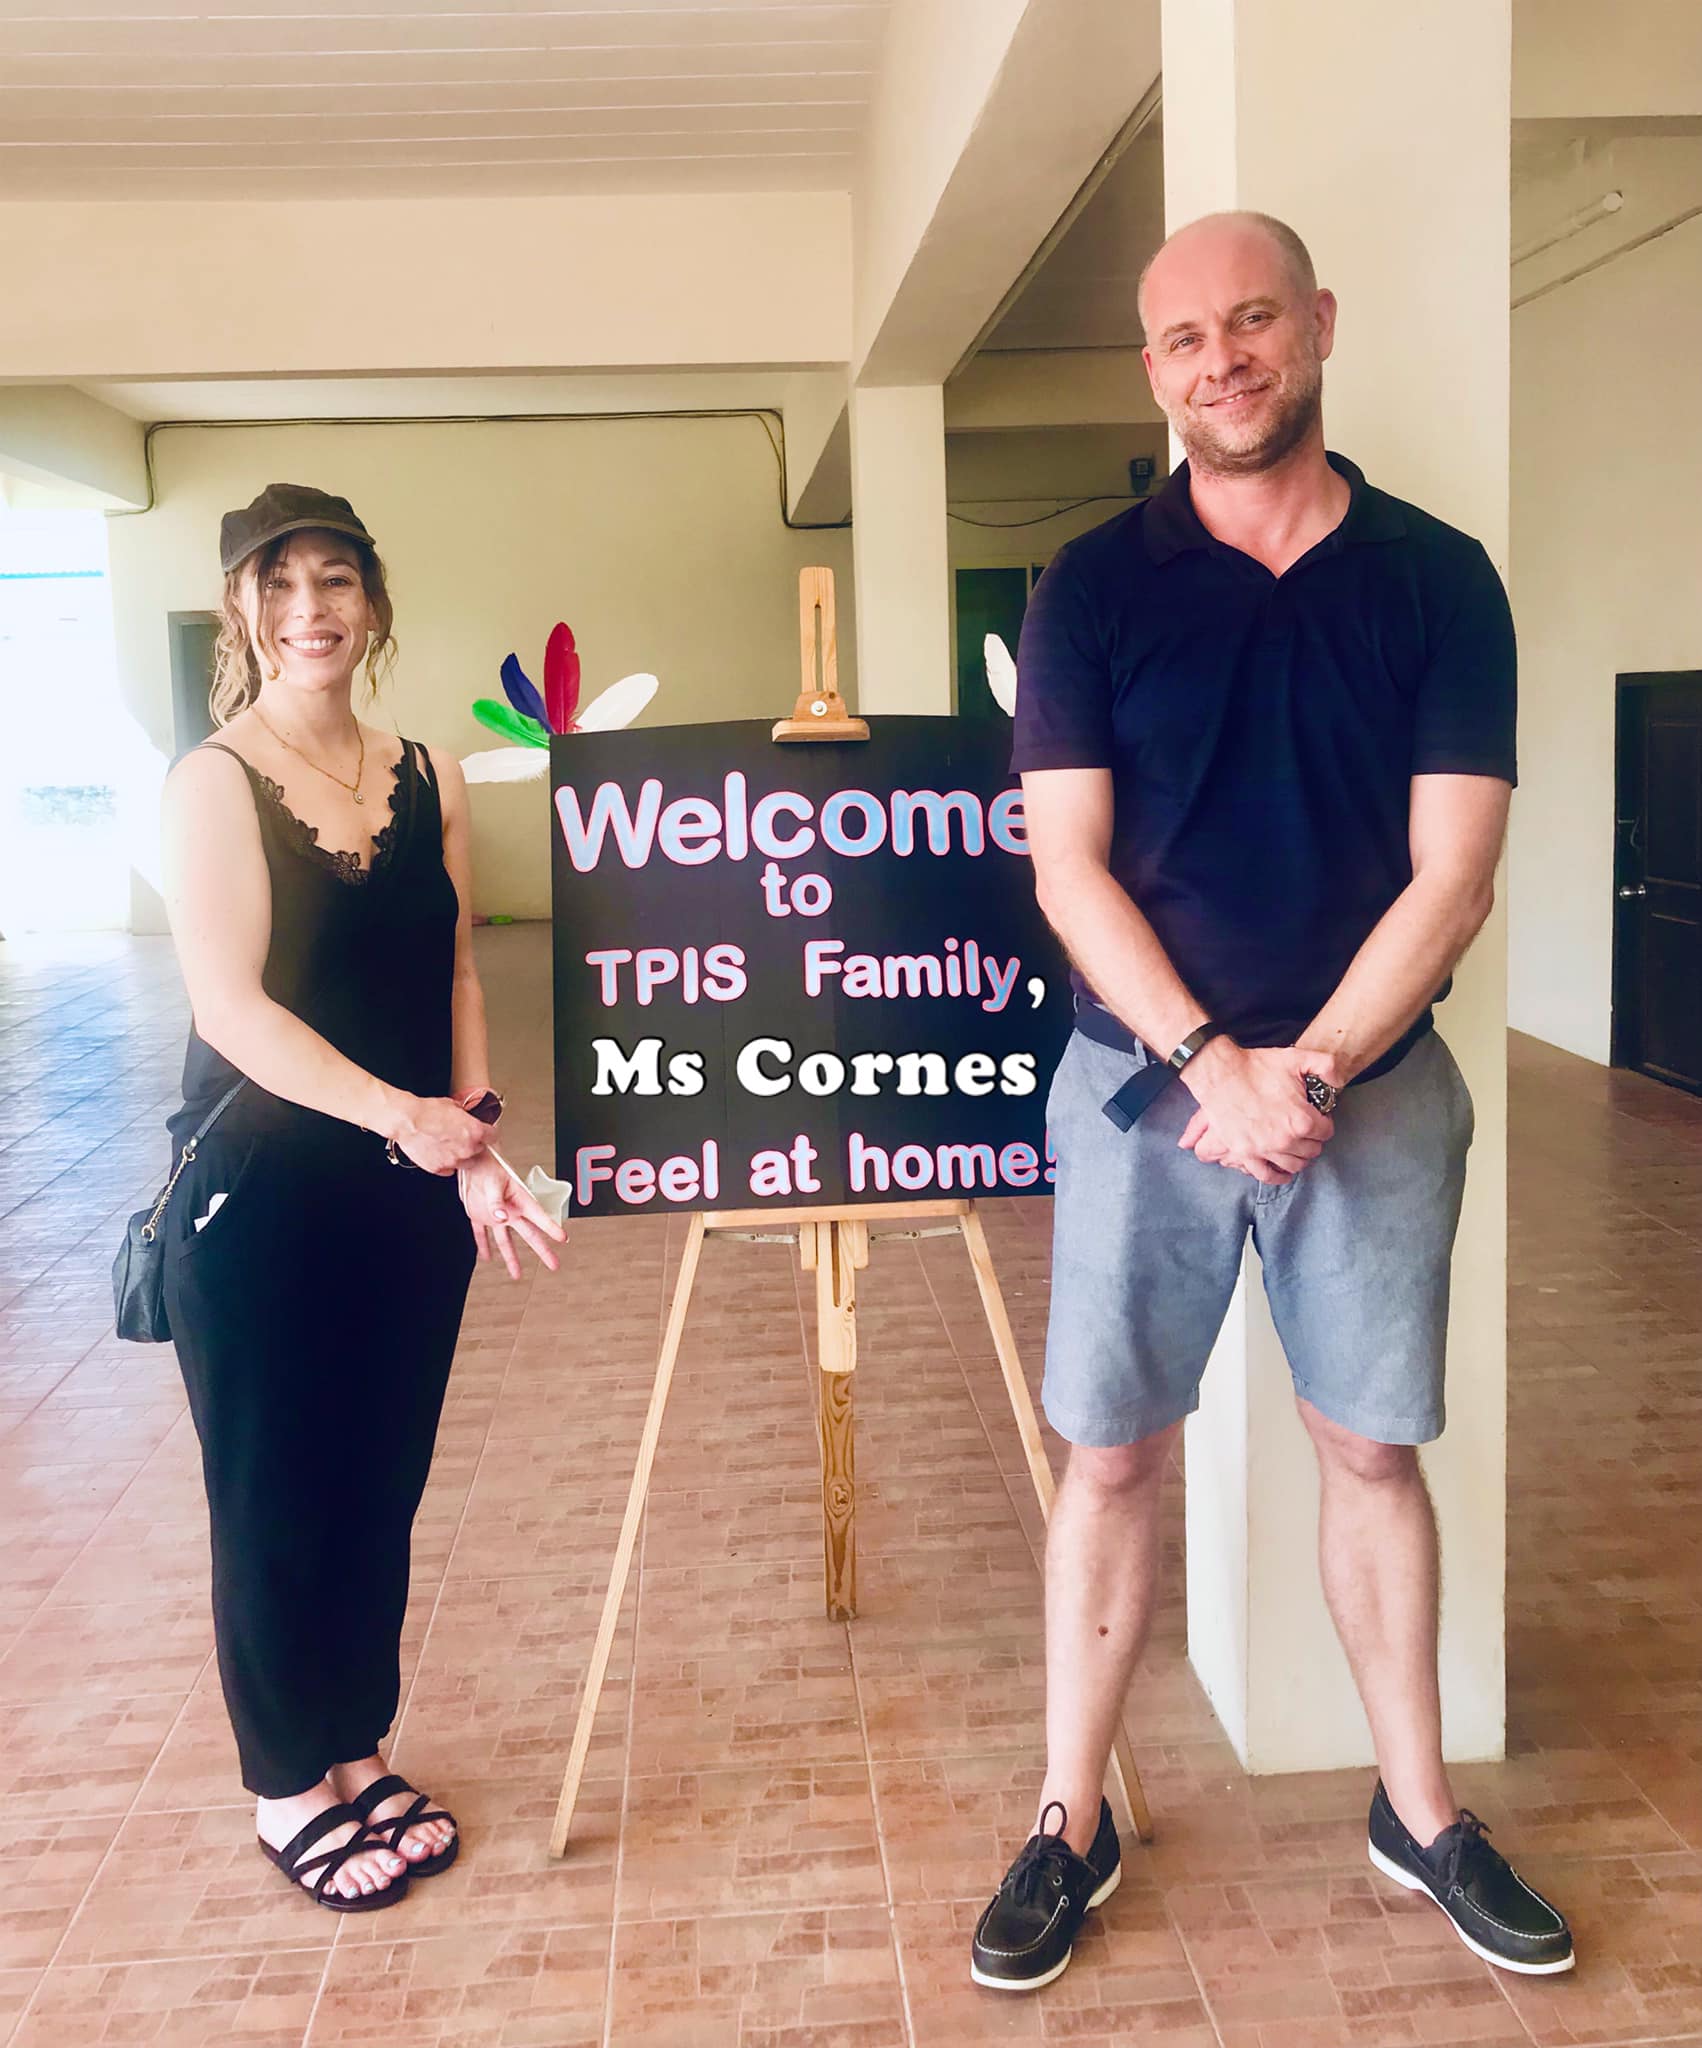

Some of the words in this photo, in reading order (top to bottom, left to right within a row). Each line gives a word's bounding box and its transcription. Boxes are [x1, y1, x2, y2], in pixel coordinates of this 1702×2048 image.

[555, 771, 1031, 873] Welcome
[760, 862, 832, 917] to
[585, 944, 748, 1007] TPIS
[576, 1139, 719, 1206] Feel
[750, 1134, 821, 1196] at
